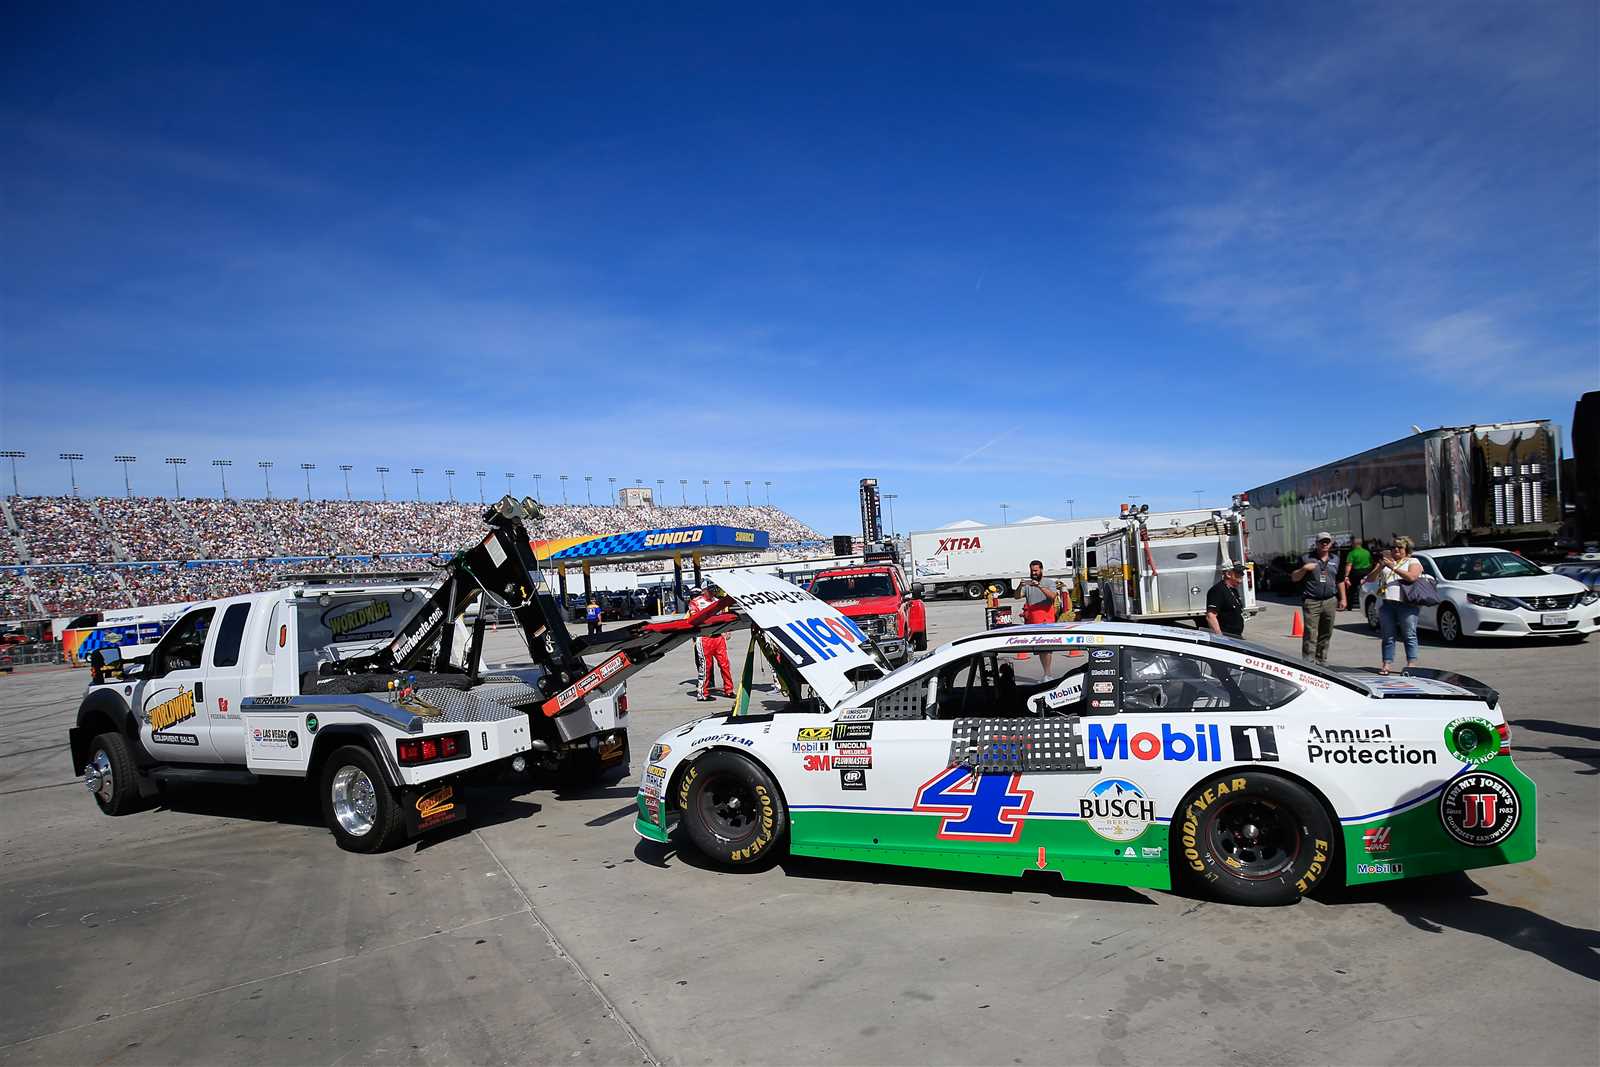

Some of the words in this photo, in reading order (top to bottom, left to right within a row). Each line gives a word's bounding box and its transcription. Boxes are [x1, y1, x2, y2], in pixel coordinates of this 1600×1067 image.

[1300, 487, 1352, 515] MONSTER
[644, 530, 703, 546] SUNOCO
[735, 532, 754, 543] SUNOCO
[934, 535, 981, 556] XTRA
[328, 600, 391, 634] WORLDWIDE
[1245, 658, 1294, 678] OUTBACK
[1049, 688, 1074, 700] Mobil
[149, 689, 196, 733] WORLDWIDE
[262, 729, 271, 738] LAS
[271, 730, 287, 738] VEGAS
[1307, 724, 1392, 743] Annual
[1448, 716, 1495, 734] AMERICAN
[180, 735, 197, 744] SALES
[690, 733, 755, 747] GOODYEAR
[792, 742, 818, 752] Mobil
[836, 742, 866, 750] LINCOLN
[1087, 723, 1222, 762] Mobil
[803, 755, 831, 772] 3M
[1307, 744, 1437, 764] Protection
[1452, 749, 1499, 766] ETHANOL
[679, 767, 699, 811] EAGLE
[912, 735, 1036, 843] 4
[1445, 777, 1477, 806] JIMMY
[1479, 777, 1514, 806] JOHN'S
[1079, 799, 1155, 822] BUSCH
[1462, 793, 1499, 828] JJ
[731, 785, 774, 862] GOODYEAR
[1182, 777, 1248, 872] GOODYEAR
[1446, 815, 1476, 841] GOURMET
[1295, 838, 1329, 894] EAGLE
[1357, 864, 1391, 873] Mobil
